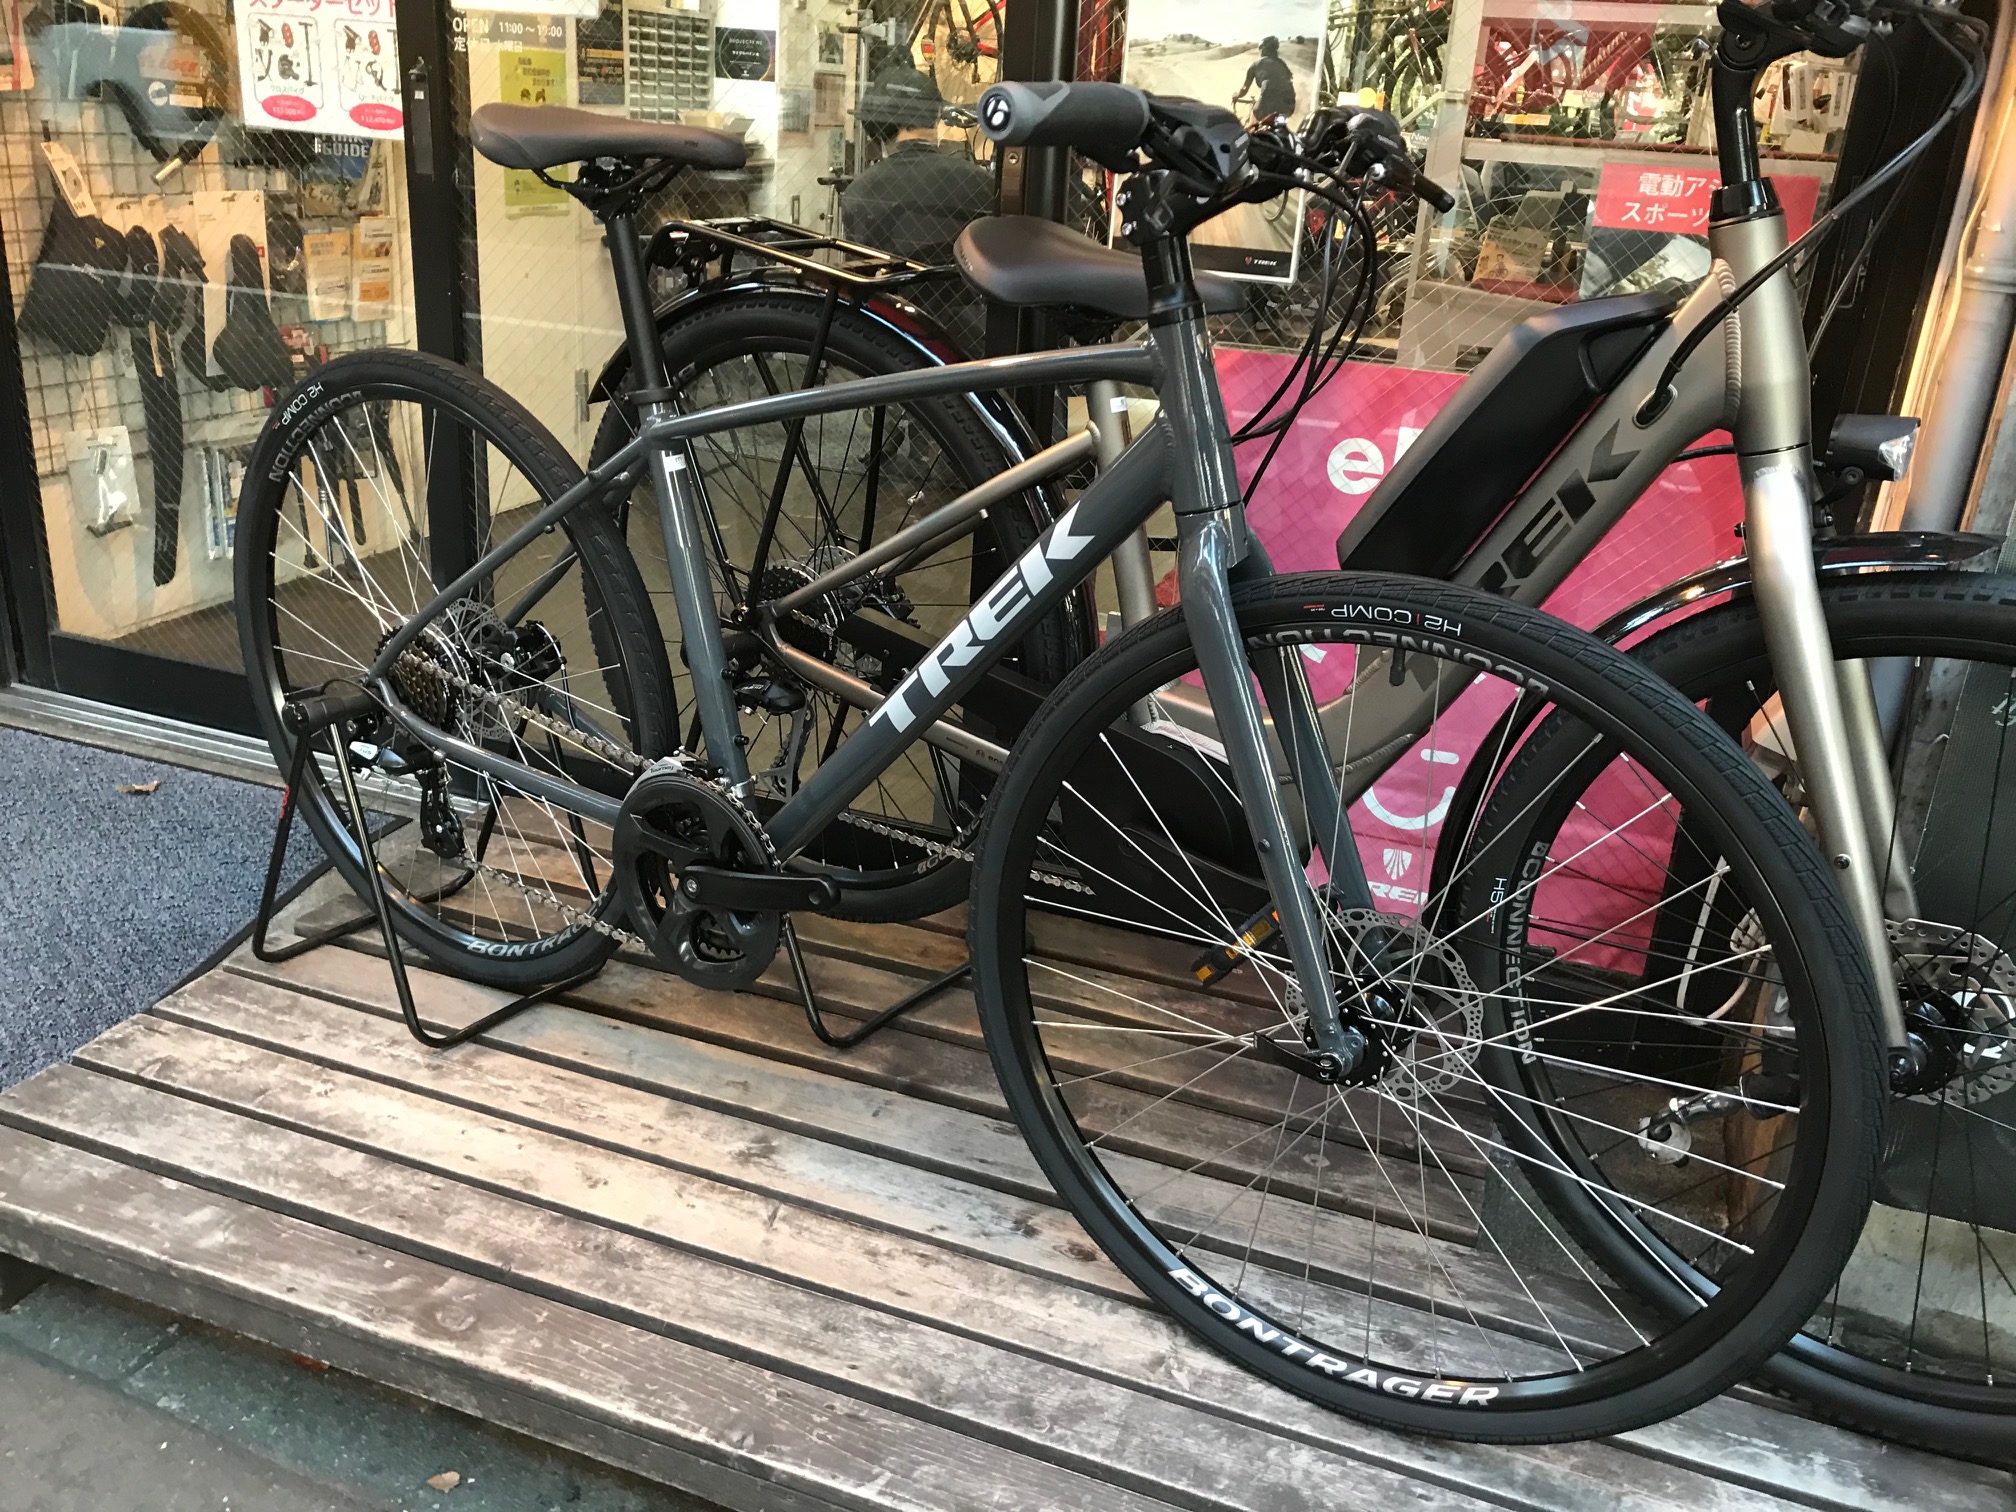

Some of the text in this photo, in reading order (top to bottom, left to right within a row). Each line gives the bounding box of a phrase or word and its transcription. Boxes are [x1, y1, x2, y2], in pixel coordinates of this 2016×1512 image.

[453, 17, 490, 33] OPEN
[322, 142, 369, 158] GUIDE
[281, 381, 324, 426] H2 COMP
[1474, 418, 1642, 600] REK
[869, 500, 1096, 733] TREK
[1331, 604, 1412, 625] COMP
[1424, 614, 1462, 637] H2
[1168, 1268, 1499, 1406] BONTRAGER
